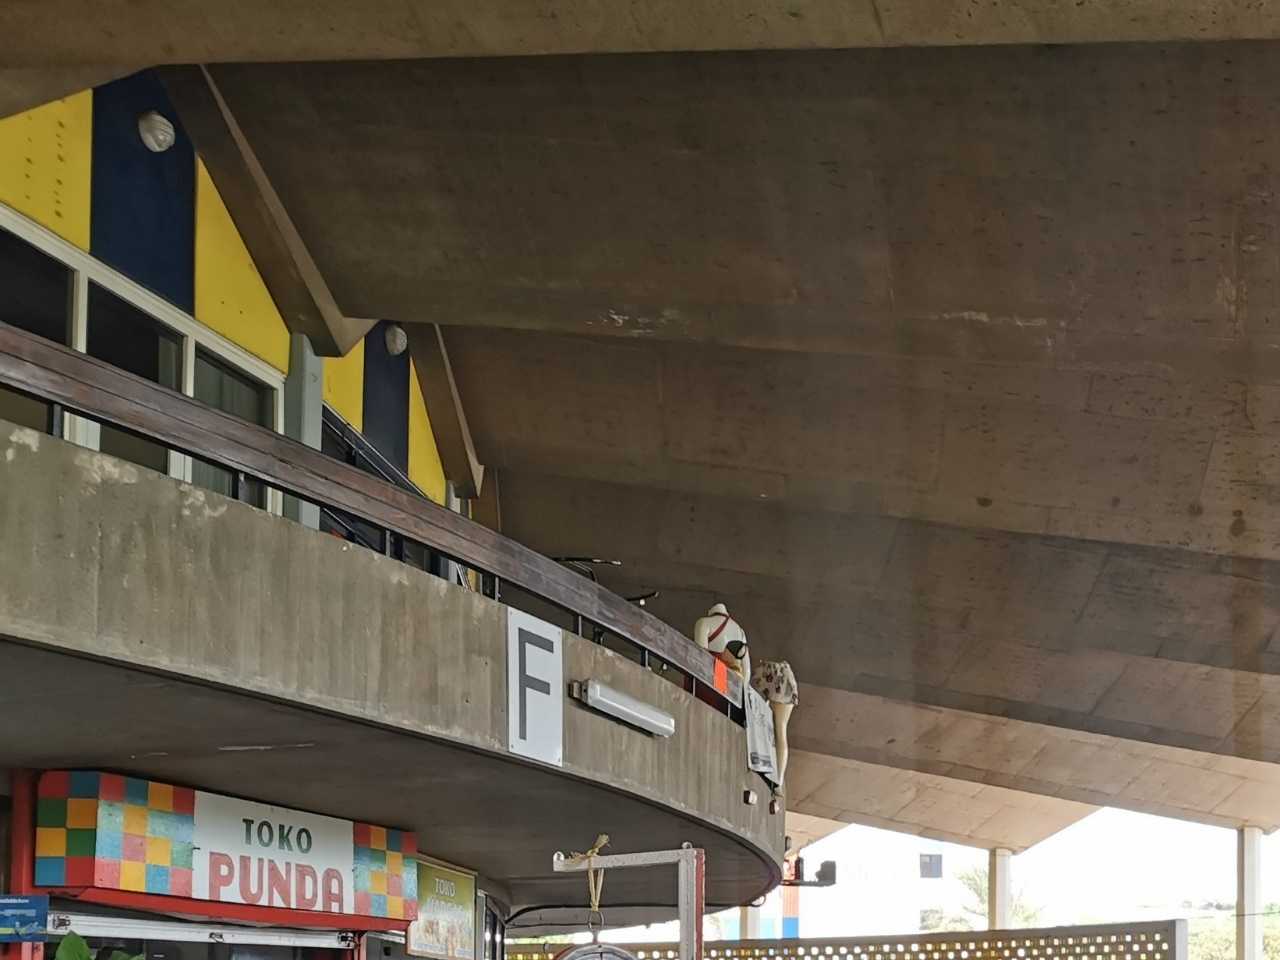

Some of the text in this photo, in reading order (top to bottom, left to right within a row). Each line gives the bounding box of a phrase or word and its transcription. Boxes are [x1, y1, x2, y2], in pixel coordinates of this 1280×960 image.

[518, 627, 554, 740] F
[242, 818, 313, 854] TOKO
[208, 851, 344, 913] PUNDA
